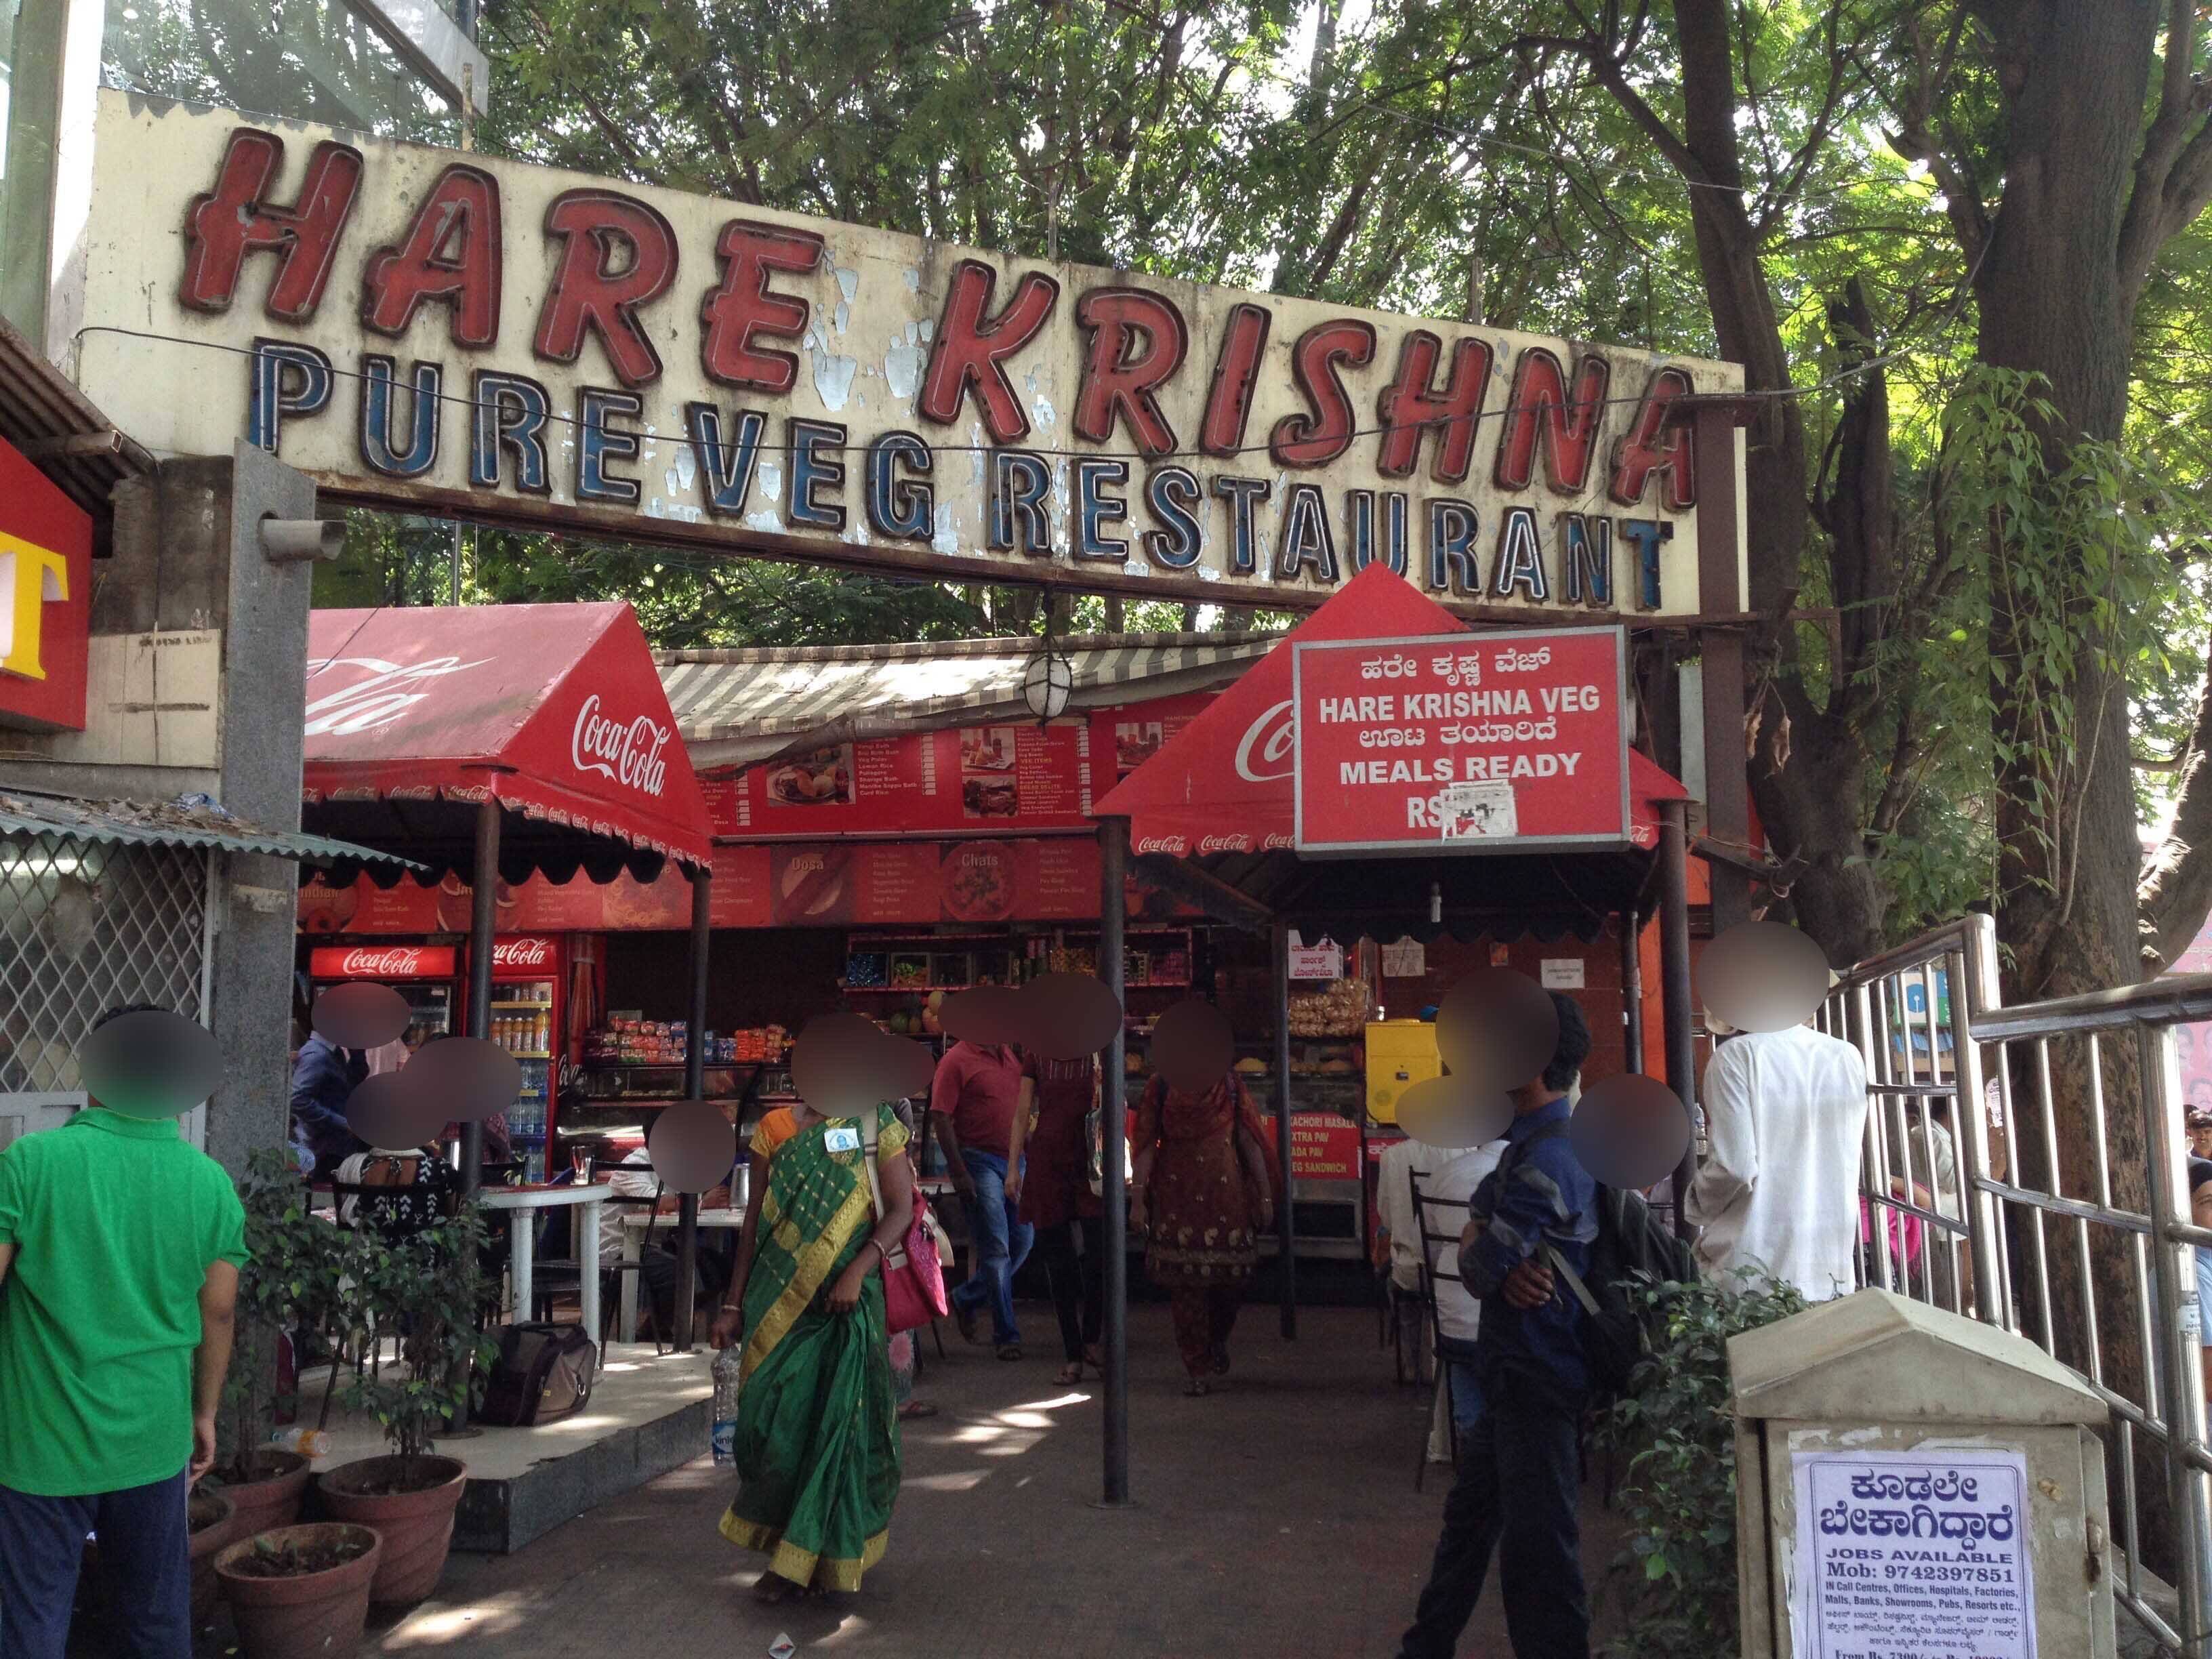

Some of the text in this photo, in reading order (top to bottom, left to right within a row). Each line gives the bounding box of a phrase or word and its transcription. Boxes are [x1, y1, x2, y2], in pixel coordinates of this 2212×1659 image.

[178, 126, 1696, 512] HARE KRISHNA
[248, 336, 1674, 611] PURE VEG RESTAURANT
[1361, 646, 1551, 687] ಹರೇ ಕೃಷ್ಣ ವೆಜ್
[1319, 685, 1601, 723] HARE KRISHNA VEG
[572, 694, 672, 797] Coca-Cola
[1359, 715, 1557, 747] ಊಟ ತಯಾರಿದೆ
[1340, 752, 1582, 785] MEALS READY
[962, 853, 998, 867] Chats
[1851, 1469, 1978, 1502] ಕೂಡಲೇ
[1820, 1500, 2013, 1551] ಬೇಕಾಗಿದ್ದಾರೆ
[1826, 1548, 2013, 1564] JOBS AVAILABLE
[1826, 1561, 2014, 1582] Mob: 9742397851
[1825, 1595, 1851, 1605] Malls,
[1854, 1595, 1883, 1607] Banks,
[1885, 1597, 1936, 1609] Showrooms,
[1939, 1599, 1962, 1610] Pubs,
[1965, 1600, 1997, 1611] Resorts
[1826, 1581, 2018, 1599] IN Call Centres, Offices, Hospitals, Factories,
